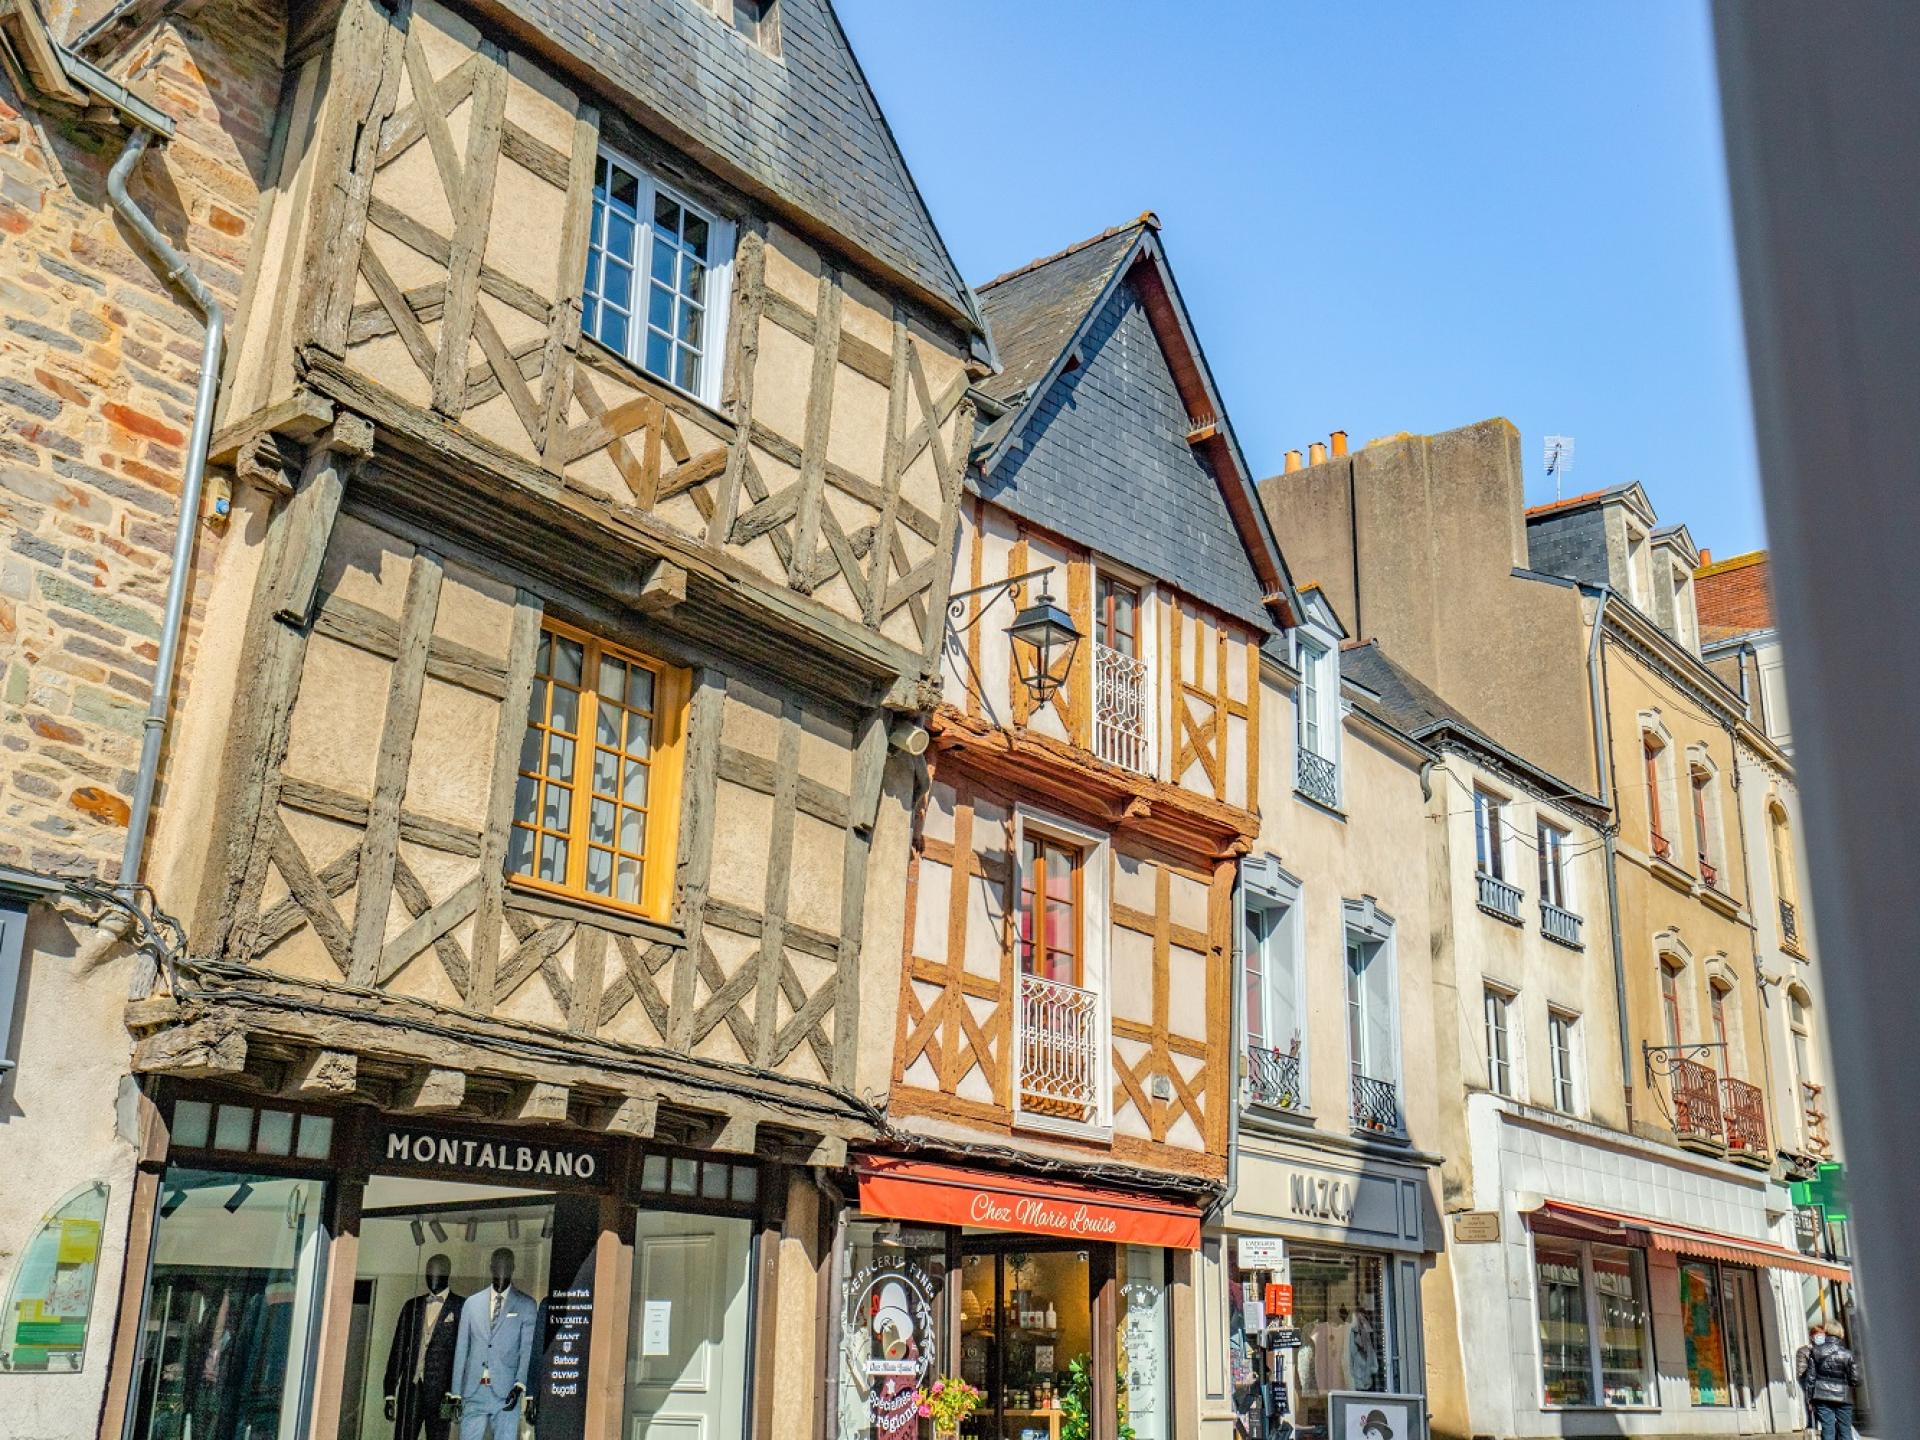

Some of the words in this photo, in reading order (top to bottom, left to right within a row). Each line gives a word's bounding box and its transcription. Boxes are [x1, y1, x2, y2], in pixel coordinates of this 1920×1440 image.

[387, 1133, 596, 1178] MONTALBANO
[1290, 1174, 1355, 1222] NAZCA
[971, 1193, 1012, 1221] Chez
[1015, 1199, 1068, 1228] Marie
[1069, 1204, 1117, 1234] Louise
[553, 1355, 579, 1365] Barbour
[551, 1371, 580, 1379] OLYMP
[551, 1382, 577, 1398] bugatti
